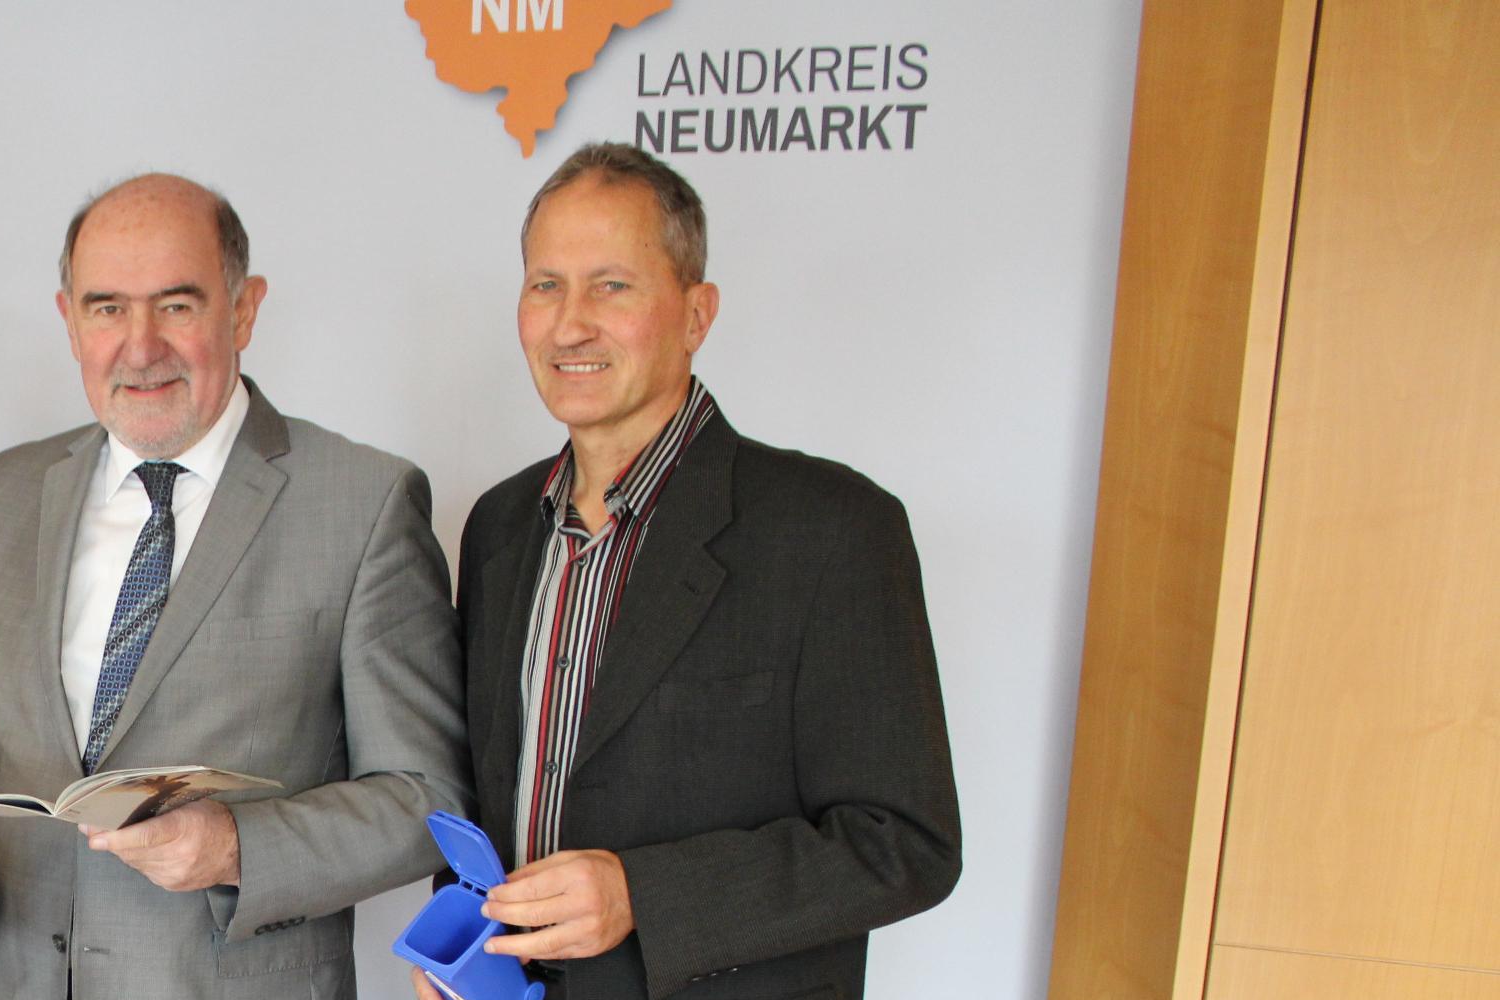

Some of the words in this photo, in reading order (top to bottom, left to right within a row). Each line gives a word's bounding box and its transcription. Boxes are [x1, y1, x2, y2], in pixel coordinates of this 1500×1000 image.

[471, 0, 564, 34] NM
[637, 43, 930, 97] LANDKREIS
[634, 103, 928, 154] NEUMARKT
